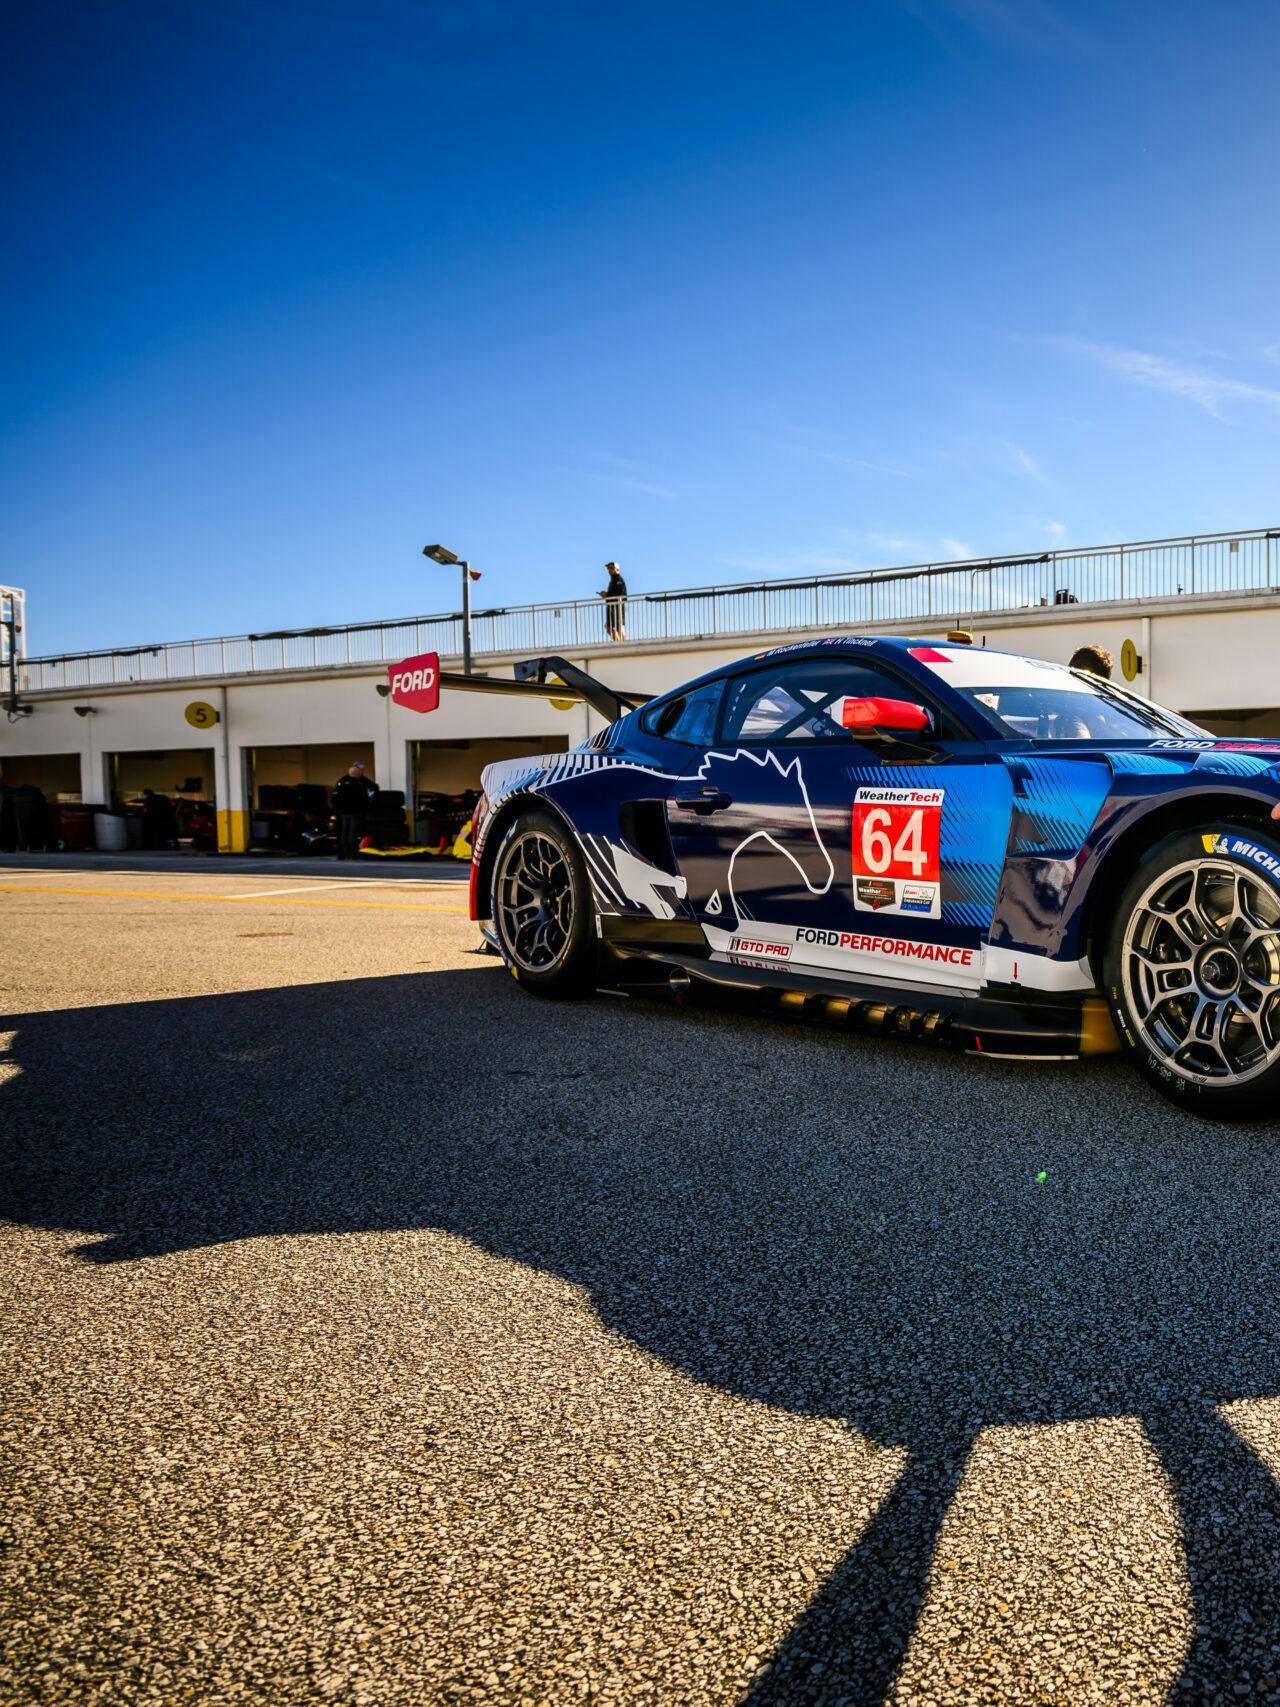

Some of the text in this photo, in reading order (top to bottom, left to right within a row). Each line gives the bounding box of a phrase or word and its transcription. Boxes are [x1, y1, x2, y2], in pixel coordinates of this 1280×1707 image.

[391, 668, 435, 695] FORD
[195, 708, 207, 723] 5
[859, 790, 941, 802] WeatherTech
[861, 807, 928, 876] 64
[740, 941, 790, 956] GTD PRO
